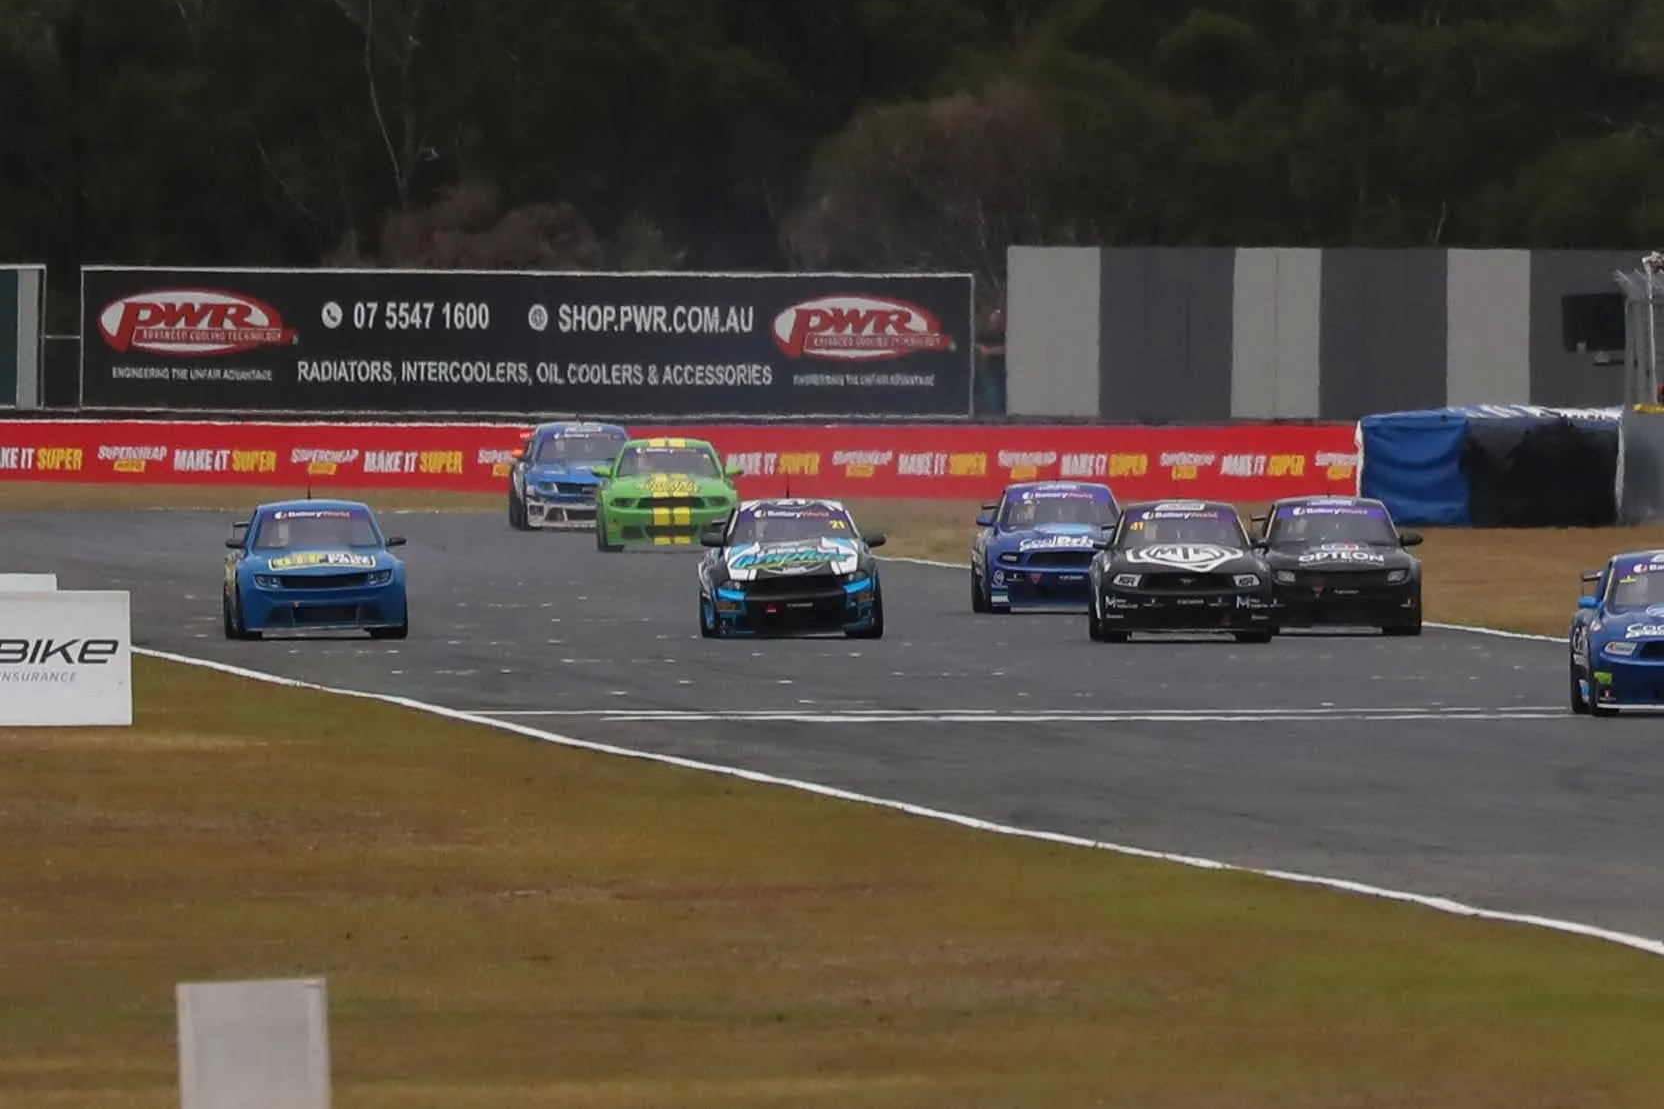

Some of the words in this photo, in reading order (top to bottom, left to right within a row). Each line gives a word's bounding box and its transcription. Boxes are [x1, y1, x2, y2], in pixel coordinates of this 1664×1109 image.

[112, 301, 256, 353] PWR
[353, 301, 378, 329] 07
[385, 301, 434, 330] 5547
[442, 301, 490, 330] 1600
[558, 303, 754, 333] SHOP.PWR.COM.AU
[297, 360, 396, 384] RADIATORS,
[401, 361, 533, 386] INTERCOOLERS,
[536, 362, 564, 384] OIL
[567, 363, 644, 385] COOLERS
[648, 364, 659, 385] &
[662, 364, 773, 386] ACCESSORIES
[0, 447, 19, 469] KE
[37, 448, 83, 470] SUPER
[174, 449, 213, 471] MAKE
[214, 449, 230, 471] IT
[232, 450, 277, 472] SUPER
[363, 451, 401, 473] MAKE
[404, 451, 418, 473] IT
[419, 451, 464, 474] SUPER
